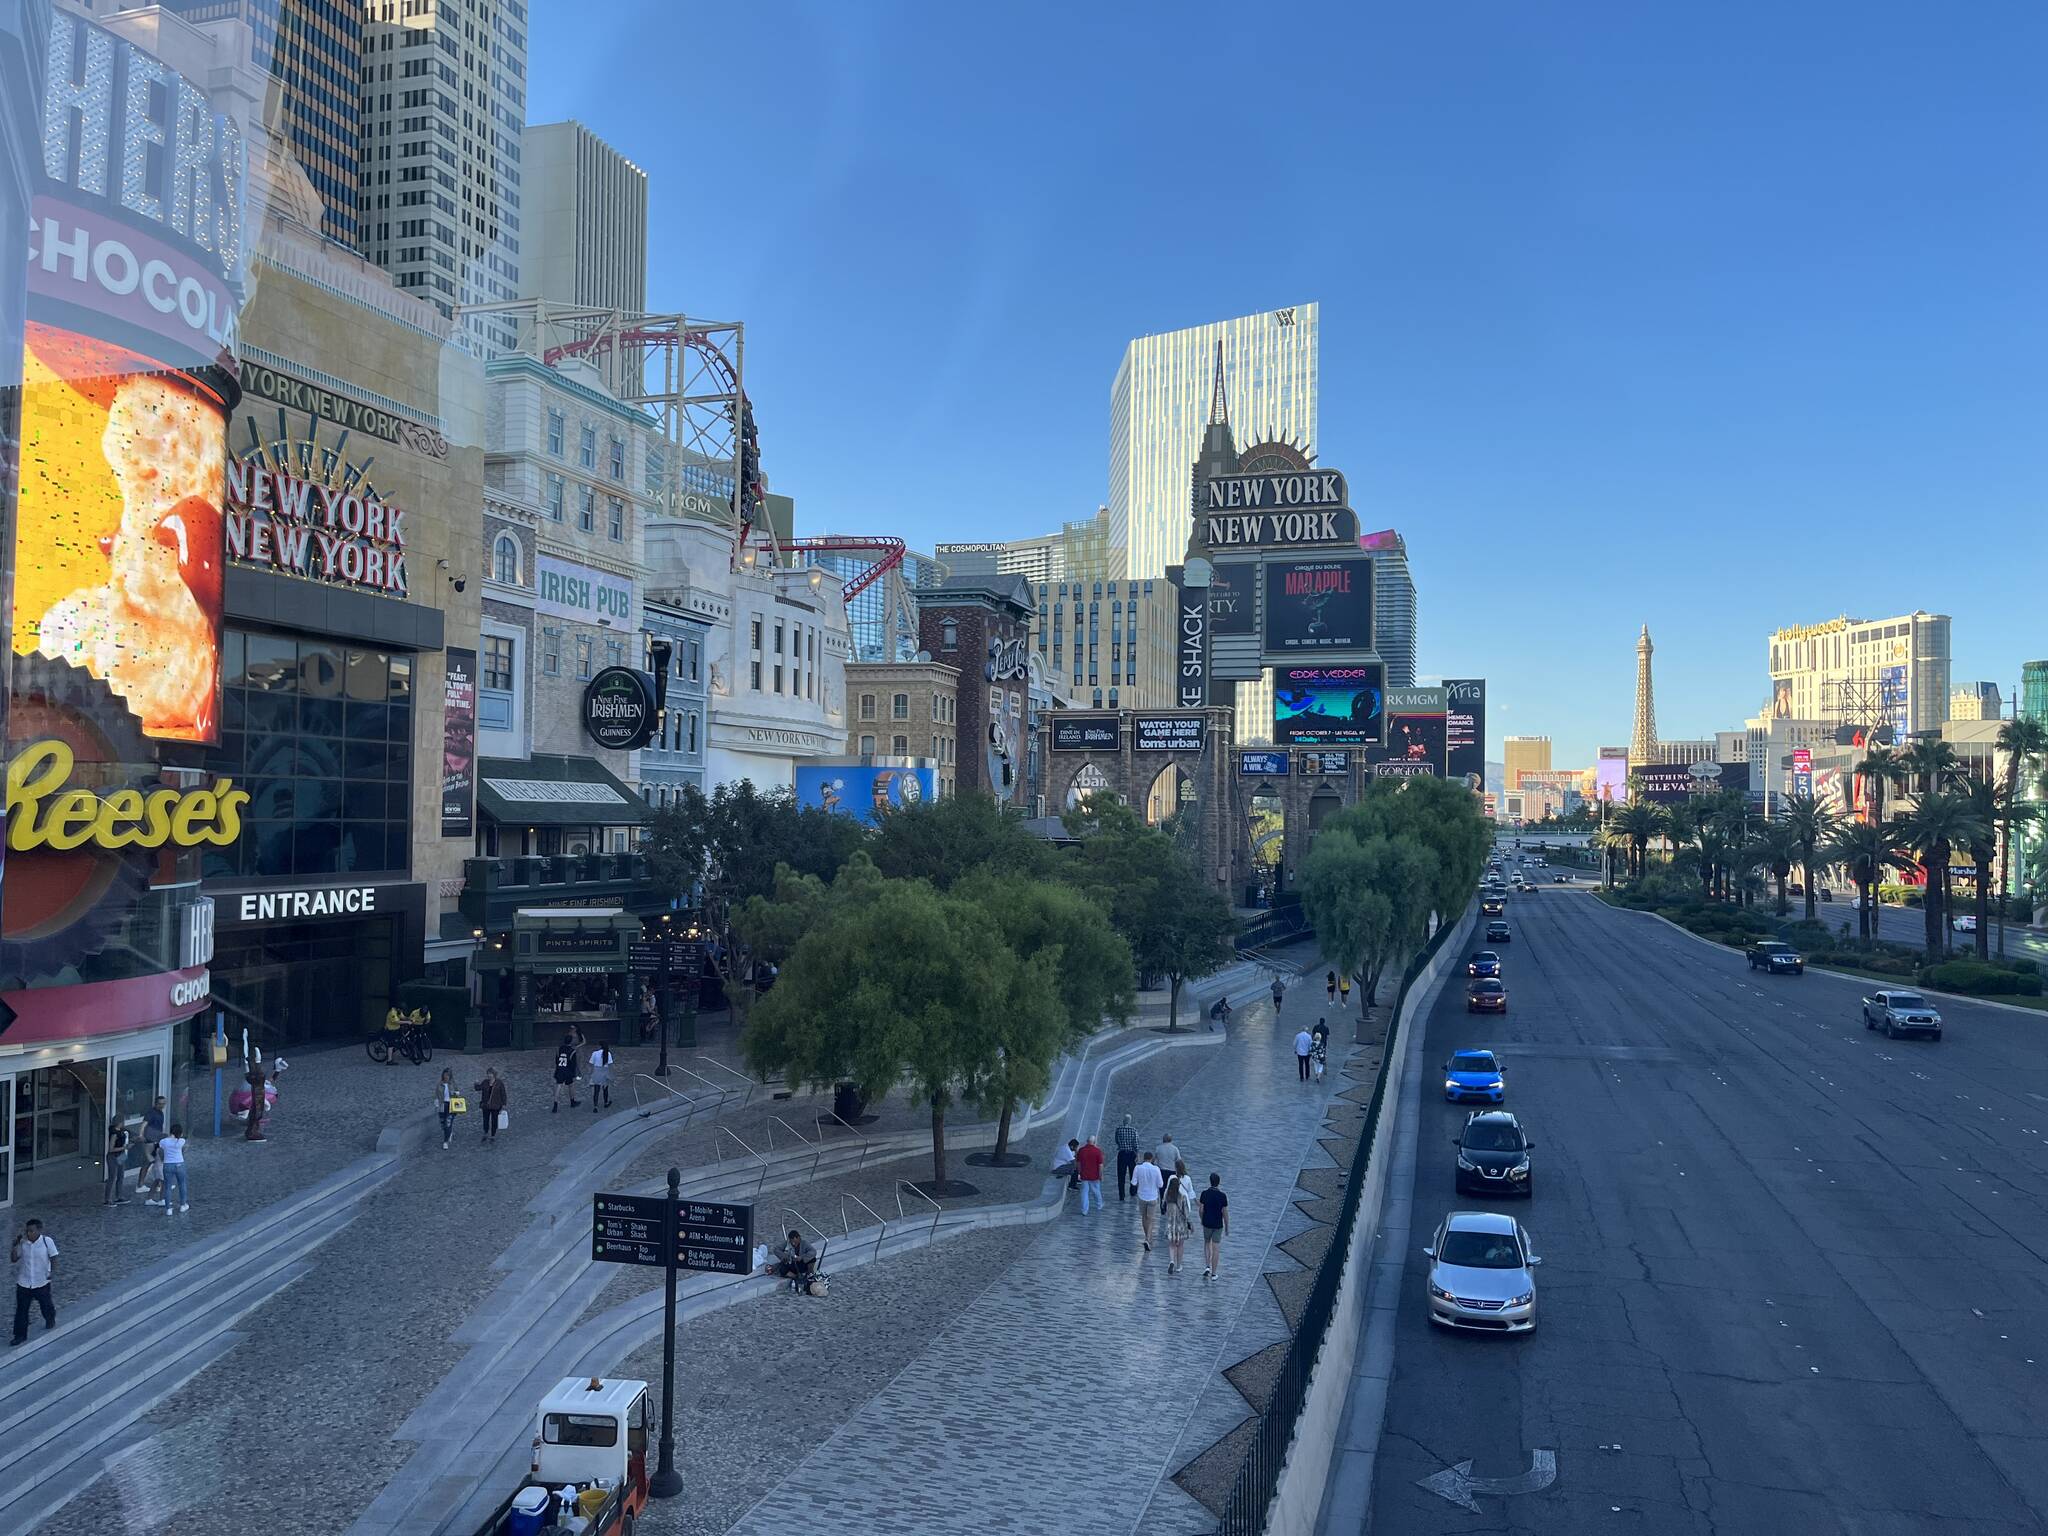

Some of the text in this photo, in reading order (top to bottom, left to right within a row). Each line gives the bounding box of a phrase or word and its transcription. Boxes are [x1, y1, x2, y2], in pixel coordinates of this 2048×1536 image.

[246, 366, 402, 441] YORK NEW YORK
[1208, 474, 1339, 508] NEW YORK
[227, 459, 407, 547] NEW YORK
[1208, 512, 1338, 544] NEW YORK
[225, 508, 407, 592] NEW YORK
[936, 543, 1007, 553] THE COSMOPOLITAN
[1285, 570, 1351, 595] MAD APPLE
[540, 570, 629, 620] IRISH PUB
[1778, 613, 1847, 642] hollywood
[1182, 603, 1203, 677] SHACK
[1289, 669, 1366, 679] EDDIE VEDDER
[1447, 682, 1481, 700] Aria
[597, 694, 628, 704] NINE FINE
[1406, 694, 1438, 705] MGM
[591, 699, 642, 718] IRISHMEN
[1139, 720, 1201, 729] WATCH YOUR
[600, 727, 632, 737] GUINNESS
[747, 729, 775, 742] NEW
[776, 731, 801, 745] YORK
[1172, 728, 1198, 736] HERE
[1139, 738, 1201, 748] toms urban
[1243, 755, 1268, 763] ALWAYS
[1638, 773, 1690, 781] VERYTHING
[4, 738, 251, 852] Reese's
[240, 888, 375, 921] ENTRANCE
[608, 1203, 635, 1213] Starbucks
[689, 1205, 713, 1215] T-Mobile
[723, 1208, 734, 1216] The
[689, 1213, 705, 1222] Arena
[722, 1216, 736, 1224] Park
[607, 1220, 623, 1229] Tom's
[631, 1222, 647, 1231] Shake
[606, 1228, 624, 1237] Urban
[630, 1230, 647, 1239] Shack
[688, 1232, 734, 1244] ATM Restrooms
[606, 1242, 632, 1252] Beerhaus
[639, 1245, 649, 1254] Top
[638, 1252, 656, 1262] Round
[688, 1250, 715, 1261] Big Apple
[687, 1258, 736, 1270] Coaster & Arcade
